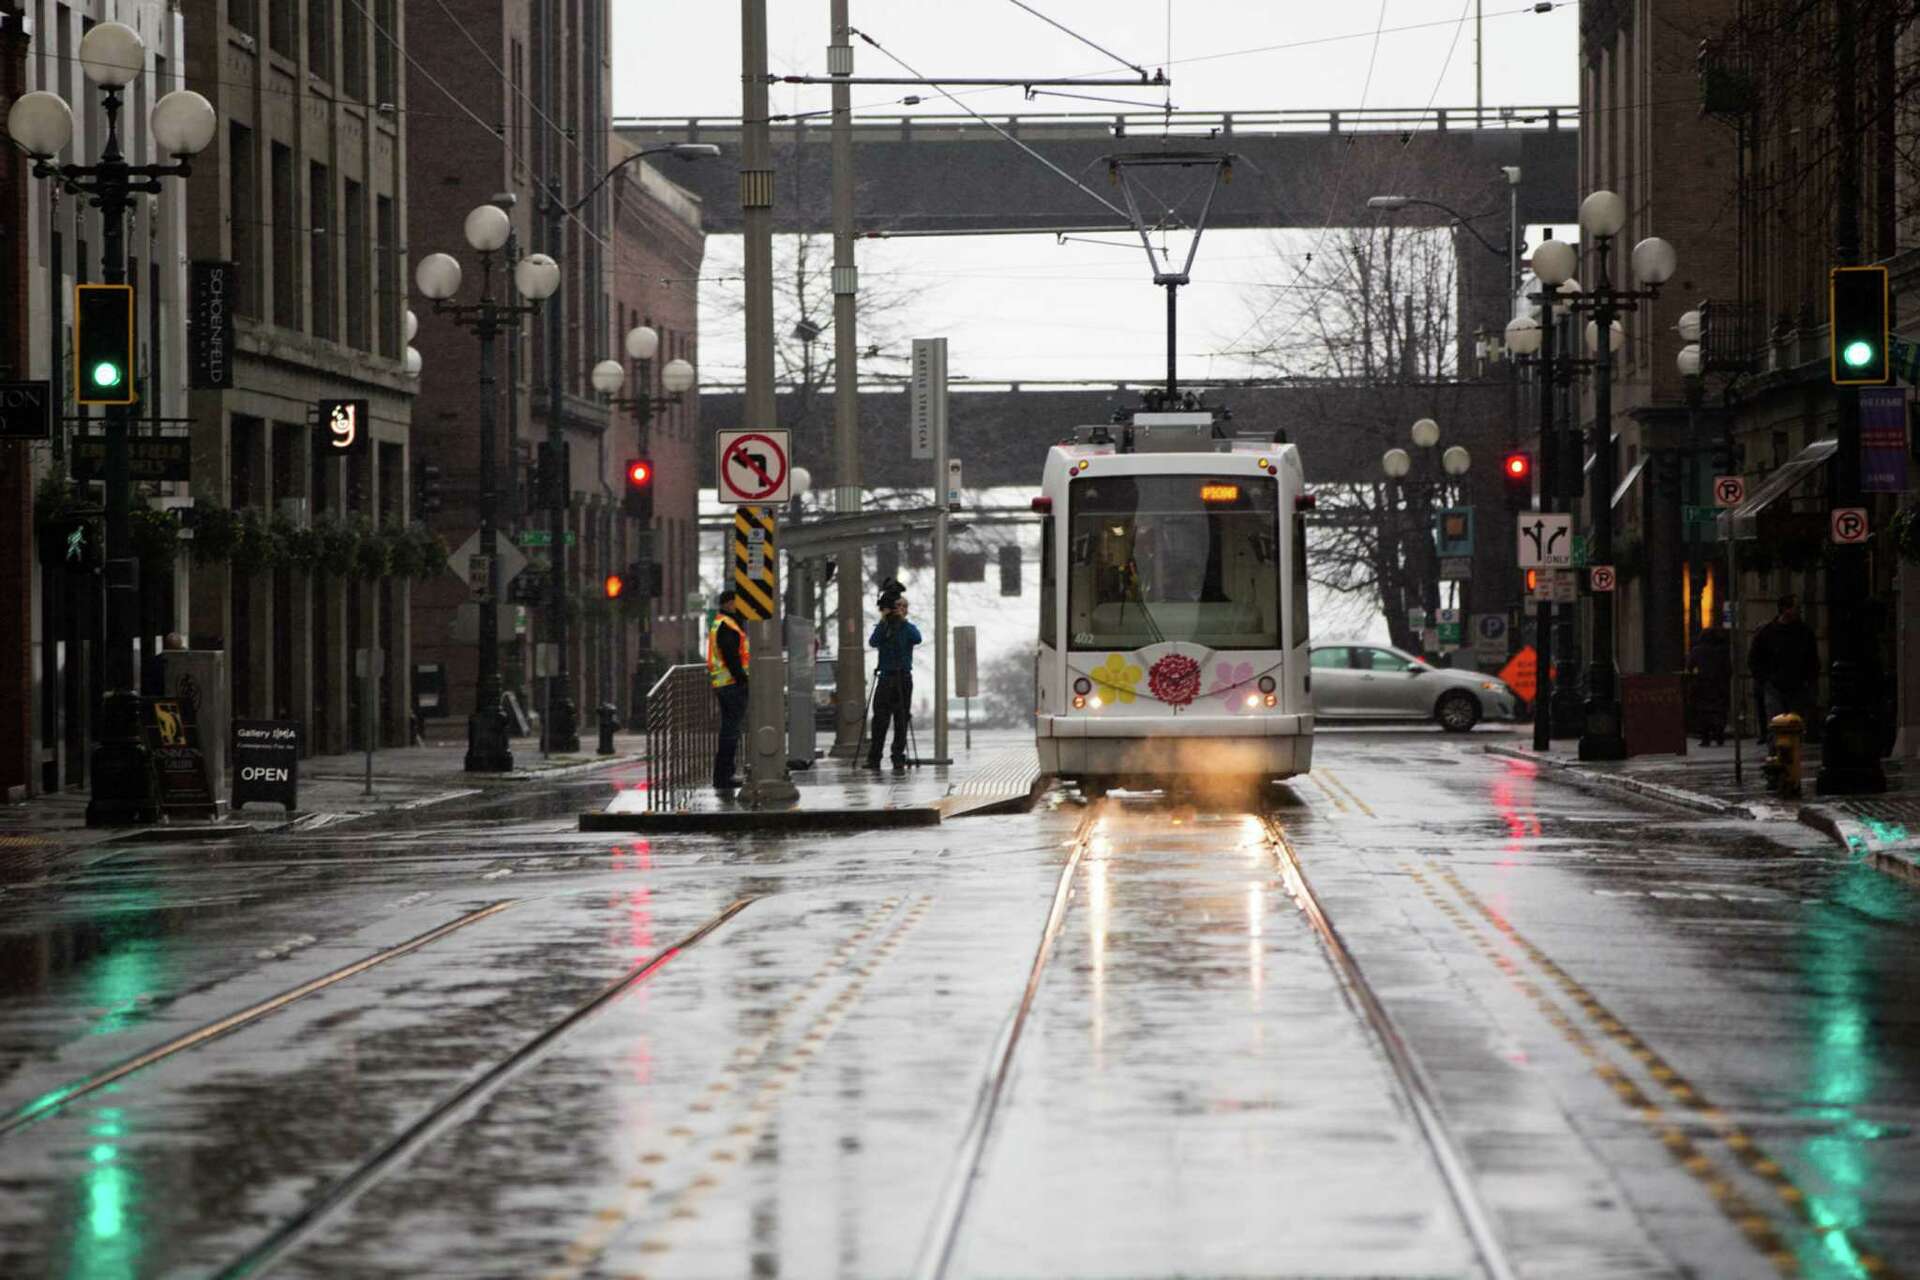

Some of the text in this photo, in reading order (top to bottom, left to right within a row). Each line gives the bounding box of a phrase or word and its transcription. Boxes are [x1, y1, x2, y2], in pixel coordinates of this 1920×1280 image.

[210, 268, 224, 384] SCHOENFELD
[919, 347, 928, 449] SEATTLE STREETCAR
[1546, 555, 1569, 564] ONLY
[237, 728, 271, 739] Gallery
[241, 767, 288, 782] OPEN
